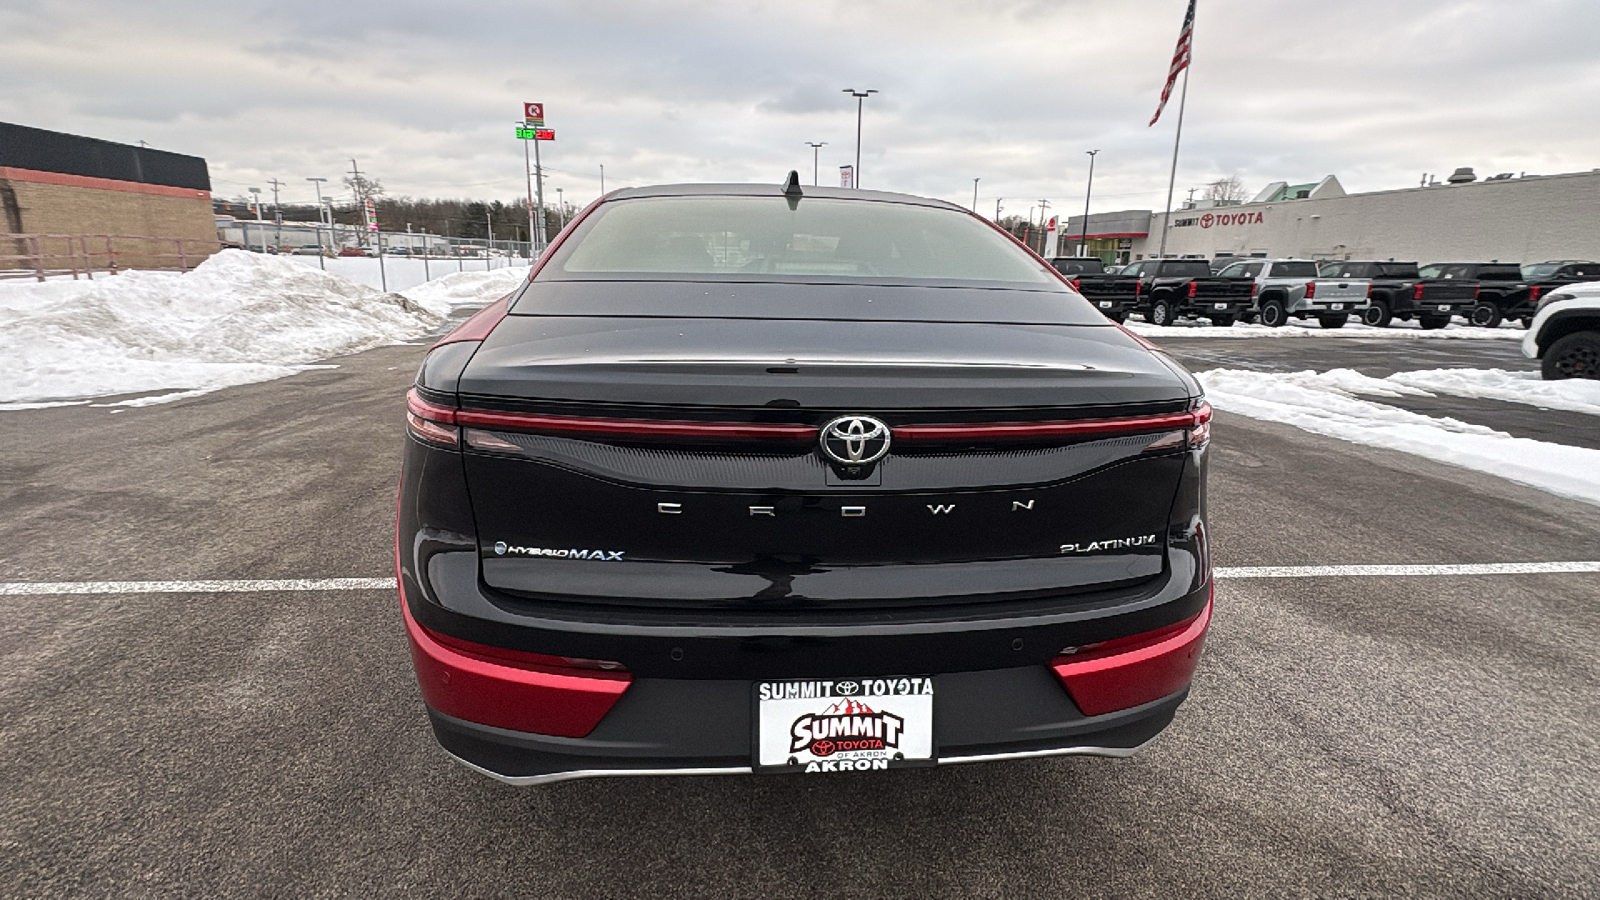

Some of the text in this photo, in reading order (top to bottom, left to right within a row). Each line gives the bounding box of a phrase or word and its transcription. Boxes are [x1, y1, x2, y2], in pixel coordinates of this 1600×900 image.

[1174, 211, 1264, 227] SUMMIT TOYOTA
[657, 499, 1035, 518] CROWN
[1060, 534, 1156, 553] PLATINUM
[759, 678, 934, 700] SUMMIT TOYOTA
[793, 712, 902, 750] SUMMIT
[836, 739, 884, 750] TOYOTA
[805, 759, 888, 773] AKRON
